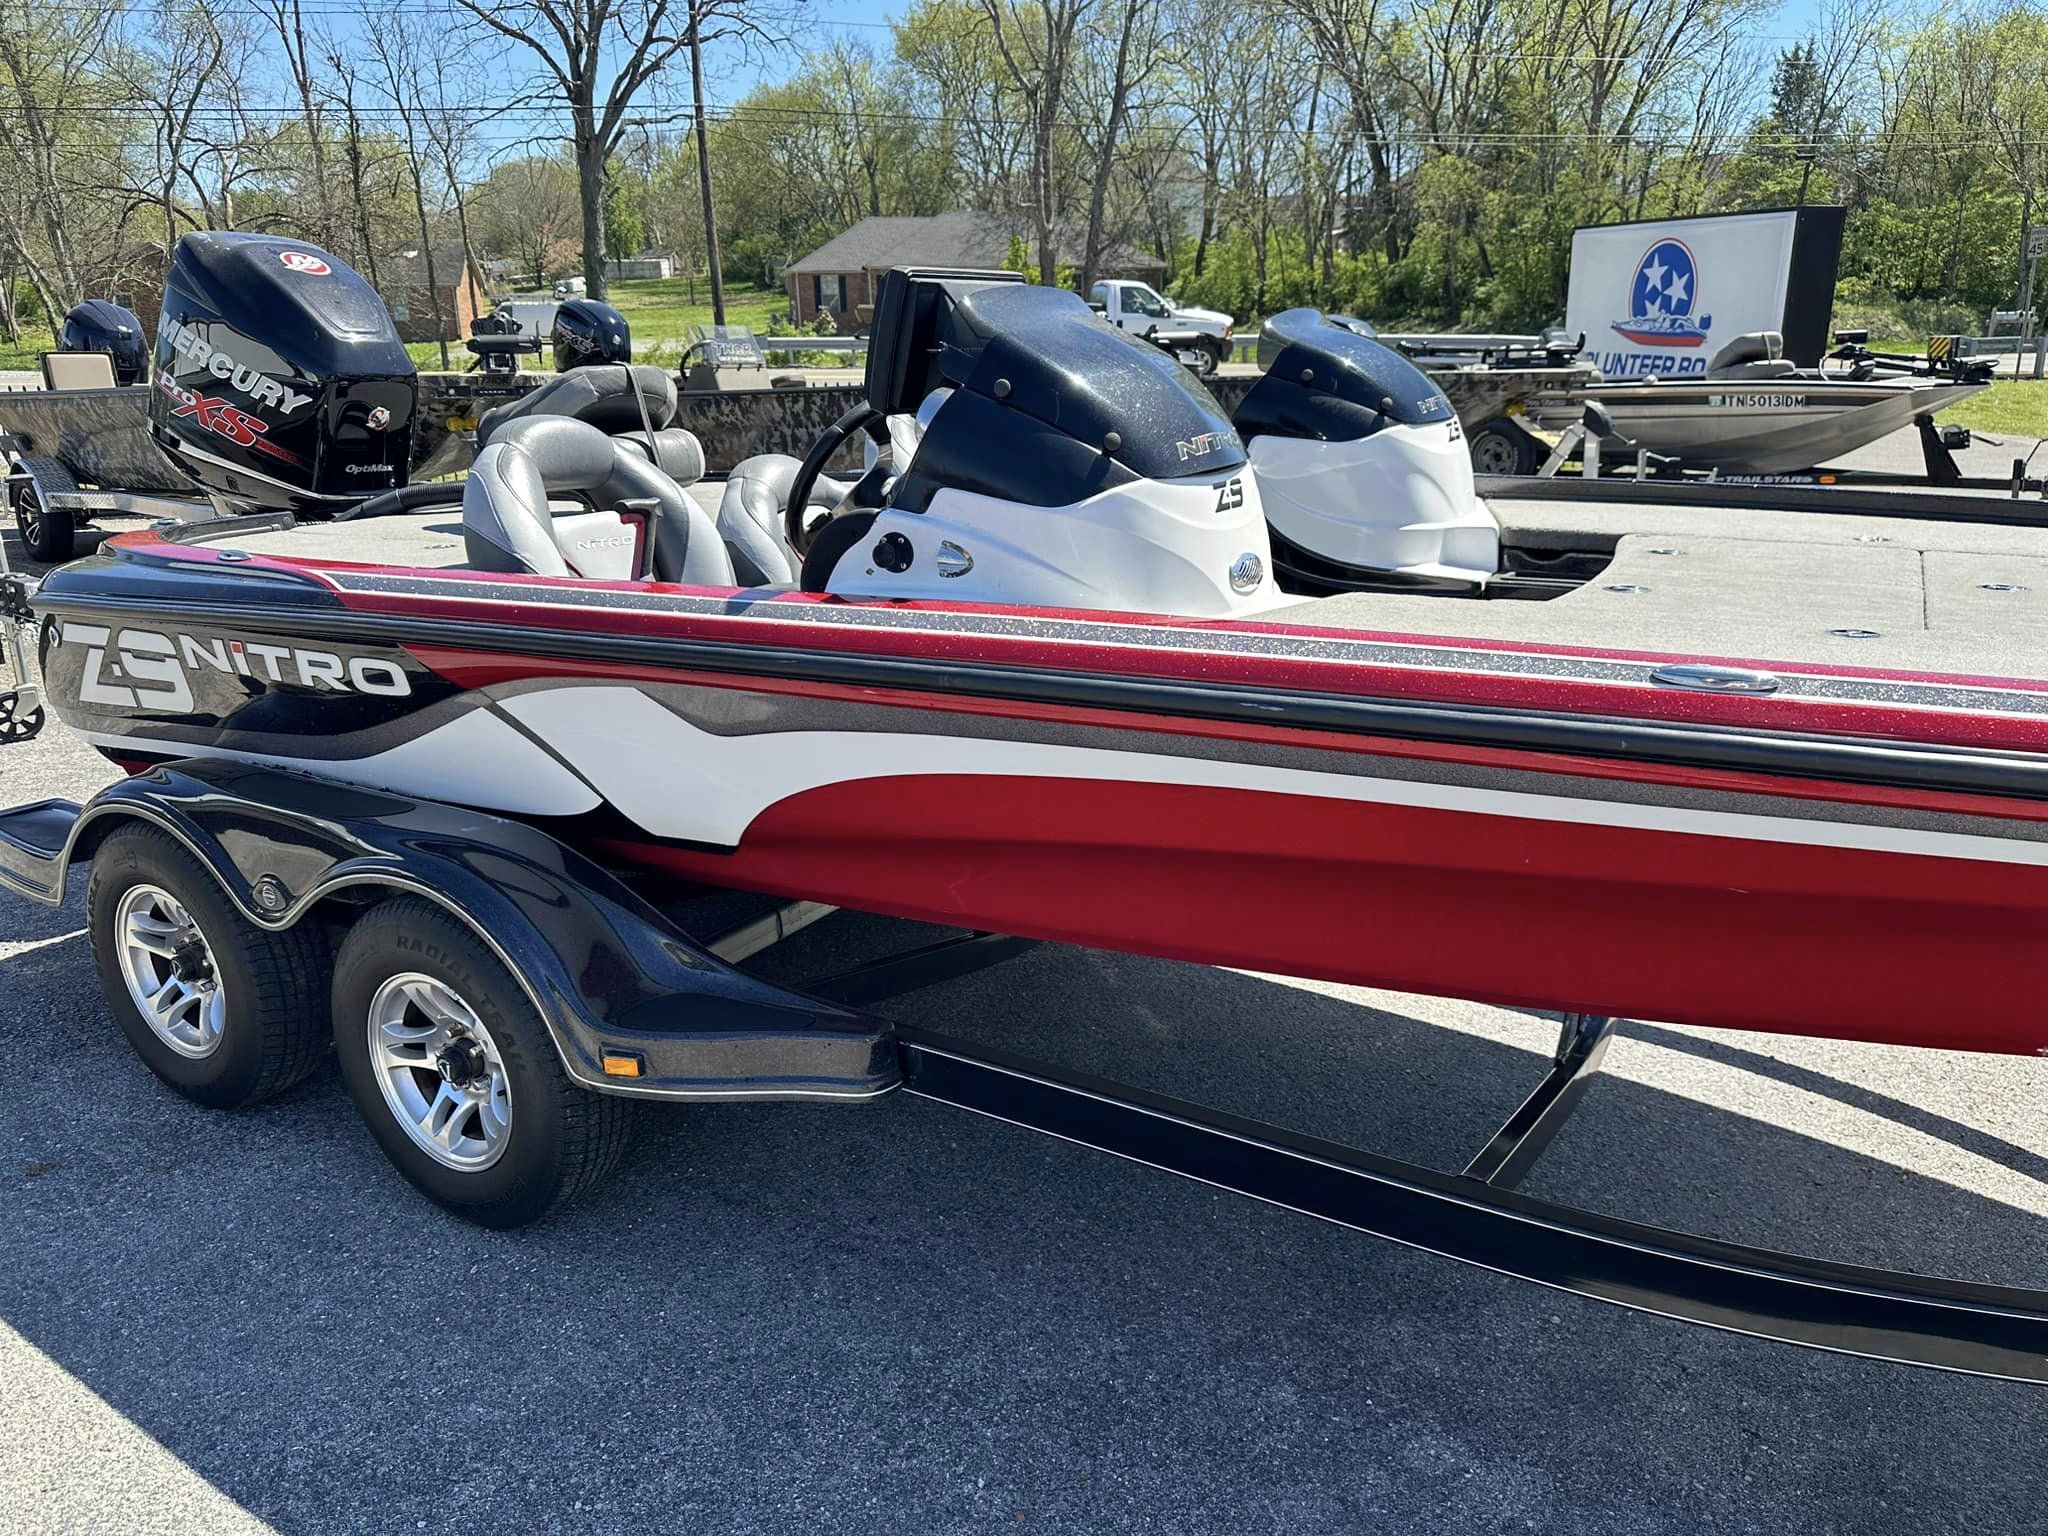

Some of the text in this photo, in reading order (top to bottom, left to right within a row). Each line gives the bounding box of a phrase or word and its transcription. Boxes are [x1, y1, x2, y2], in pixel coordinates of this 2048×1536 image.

[159, 311, 313, 415] MERCURY
[345, 463, 395, 475] OptiMax
[576, 535, 634, 551] NITRO
[178, 633, 411, 696] NITRO
